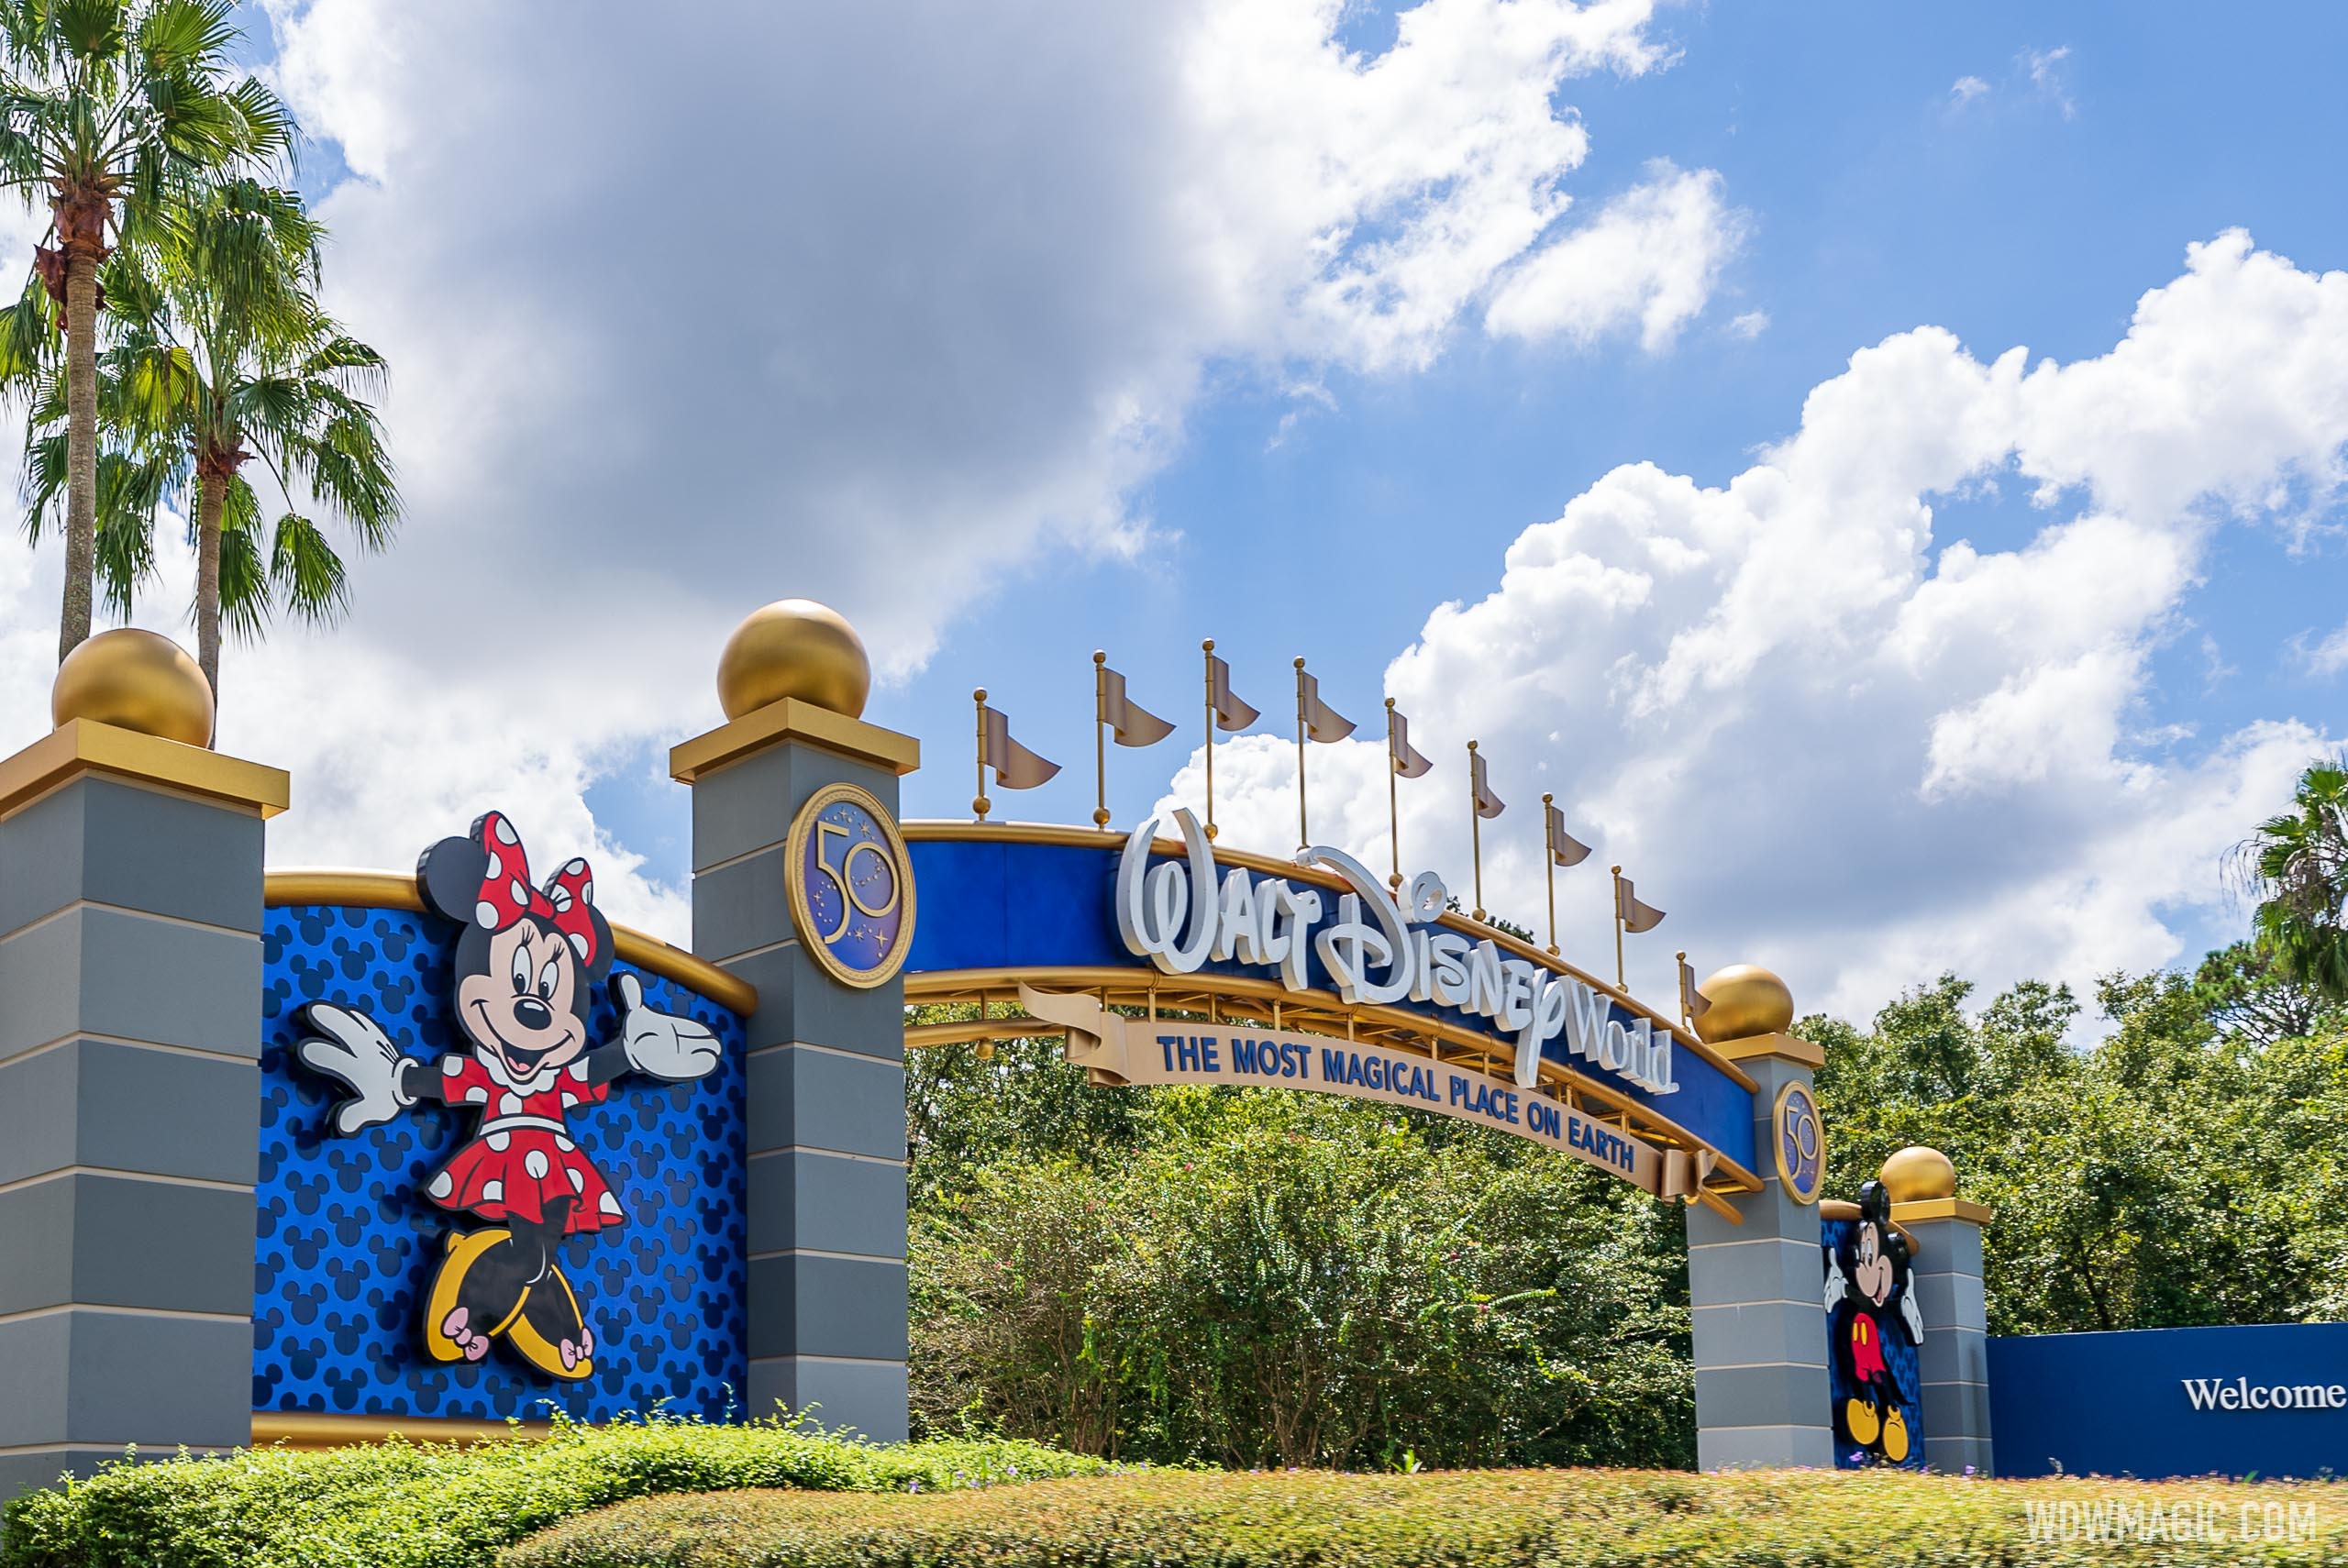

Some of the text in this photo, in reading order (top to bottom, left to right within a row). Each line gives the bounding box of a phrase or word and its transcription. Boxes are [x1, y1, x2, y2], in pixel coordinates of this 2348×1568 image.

[815, 821, 900, 944] 50
[1157, 1035, 1634, 1173] THE MOST MAGICAL PLACE ON EARTH
[1785, 1105, 1819, 1181] 50
[2180, 1376, 2347, 1411] Welcome
